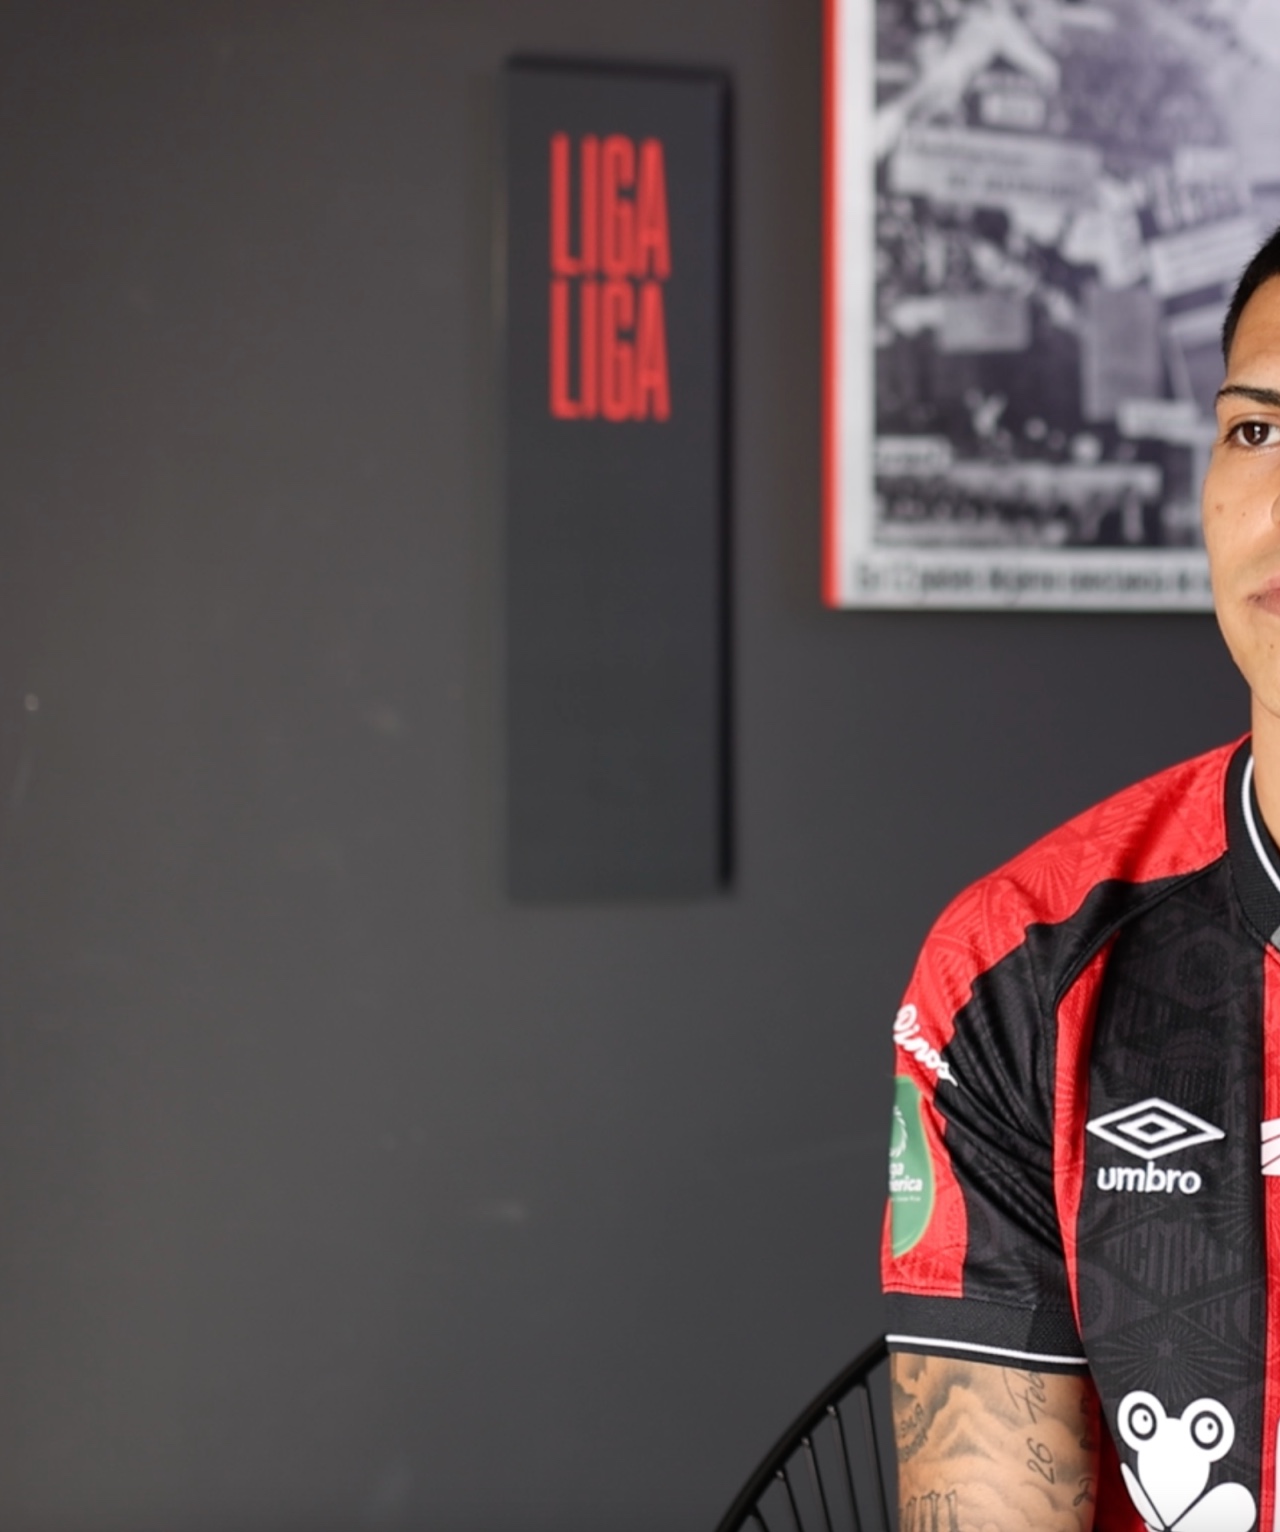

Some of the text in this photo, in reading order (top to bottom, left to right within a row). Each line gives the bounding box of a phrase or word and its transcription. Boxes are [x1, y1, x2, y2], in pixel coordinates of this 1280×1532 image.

[551, 131, 672, 281] LIGA
[551, 279, 672, 423] LIGA
[1097, 1160, 1202, 1195] umbro
